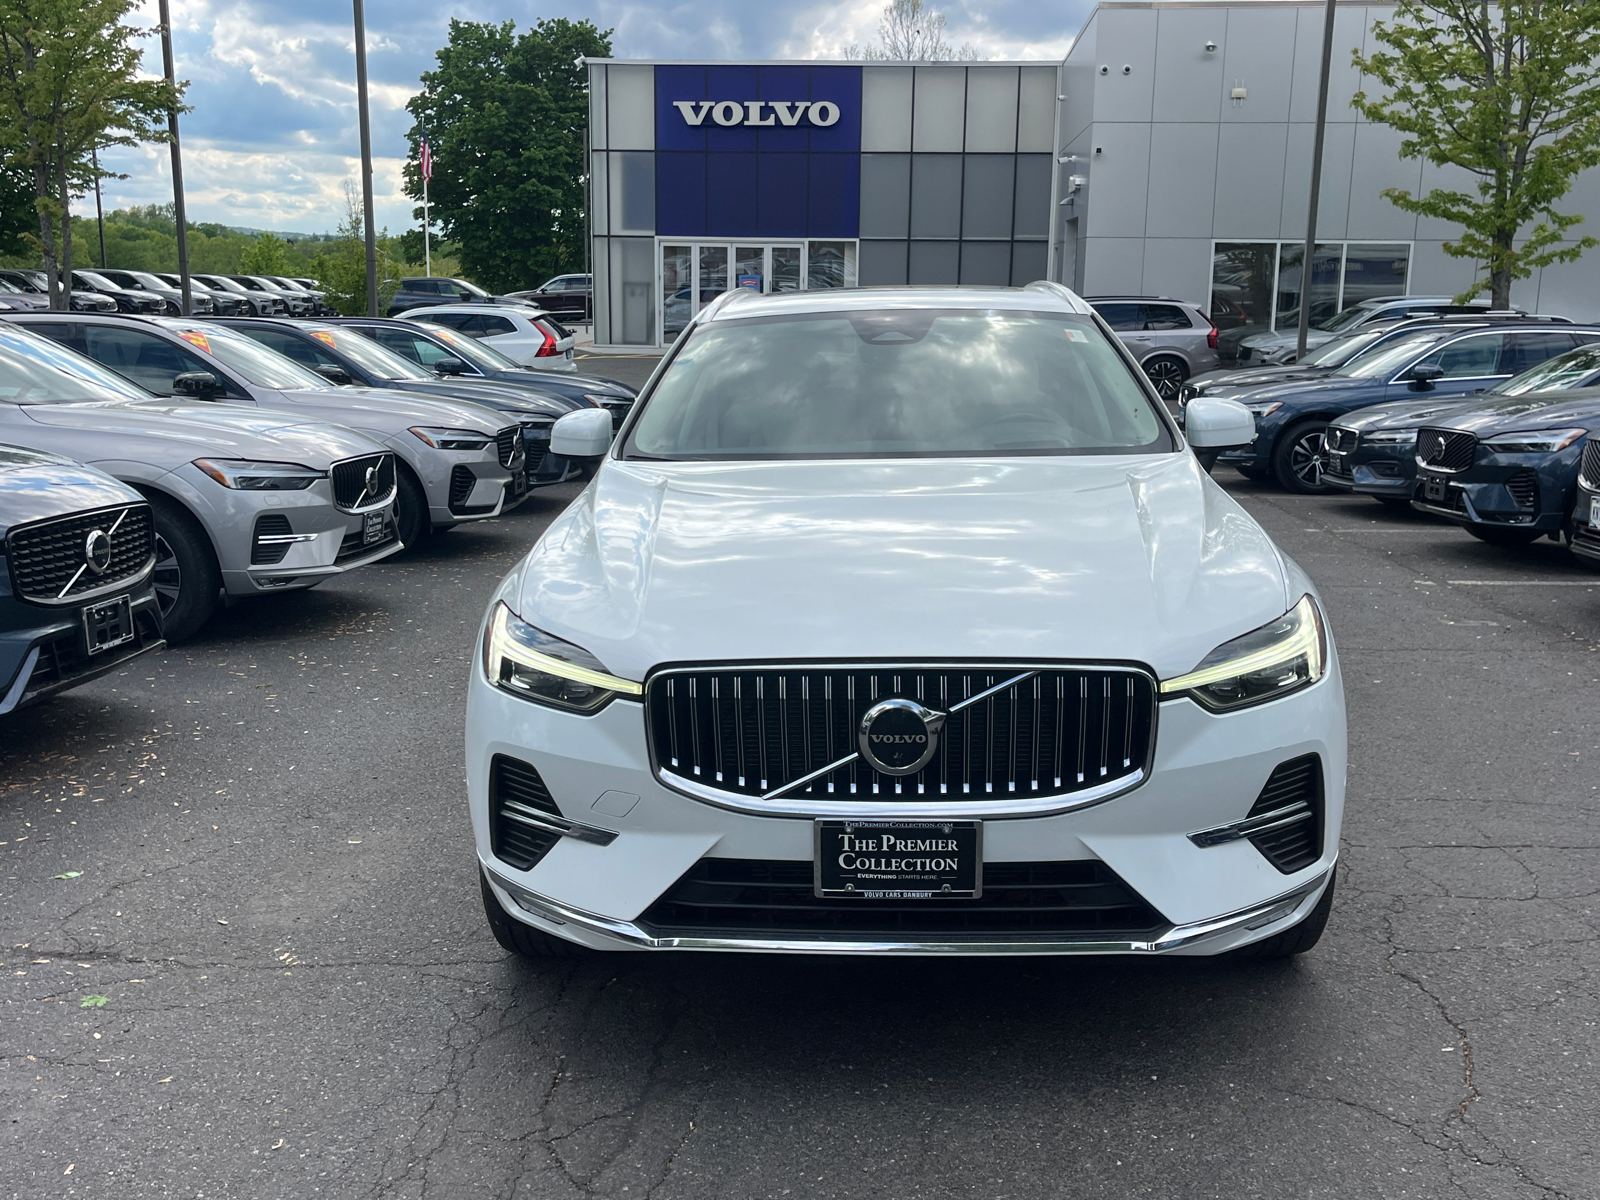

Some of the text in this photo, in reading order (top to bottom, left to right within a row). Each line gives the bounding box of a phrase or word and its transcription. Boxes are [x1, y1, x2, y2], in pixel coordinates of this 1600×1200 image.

[673, 101, 840, 126] VOLVO
[870, 734, 926, 743] VOLVO
[838, 834, 958, 852] THE PREMIER
[838, 852, 958, 871] COLLECTION
